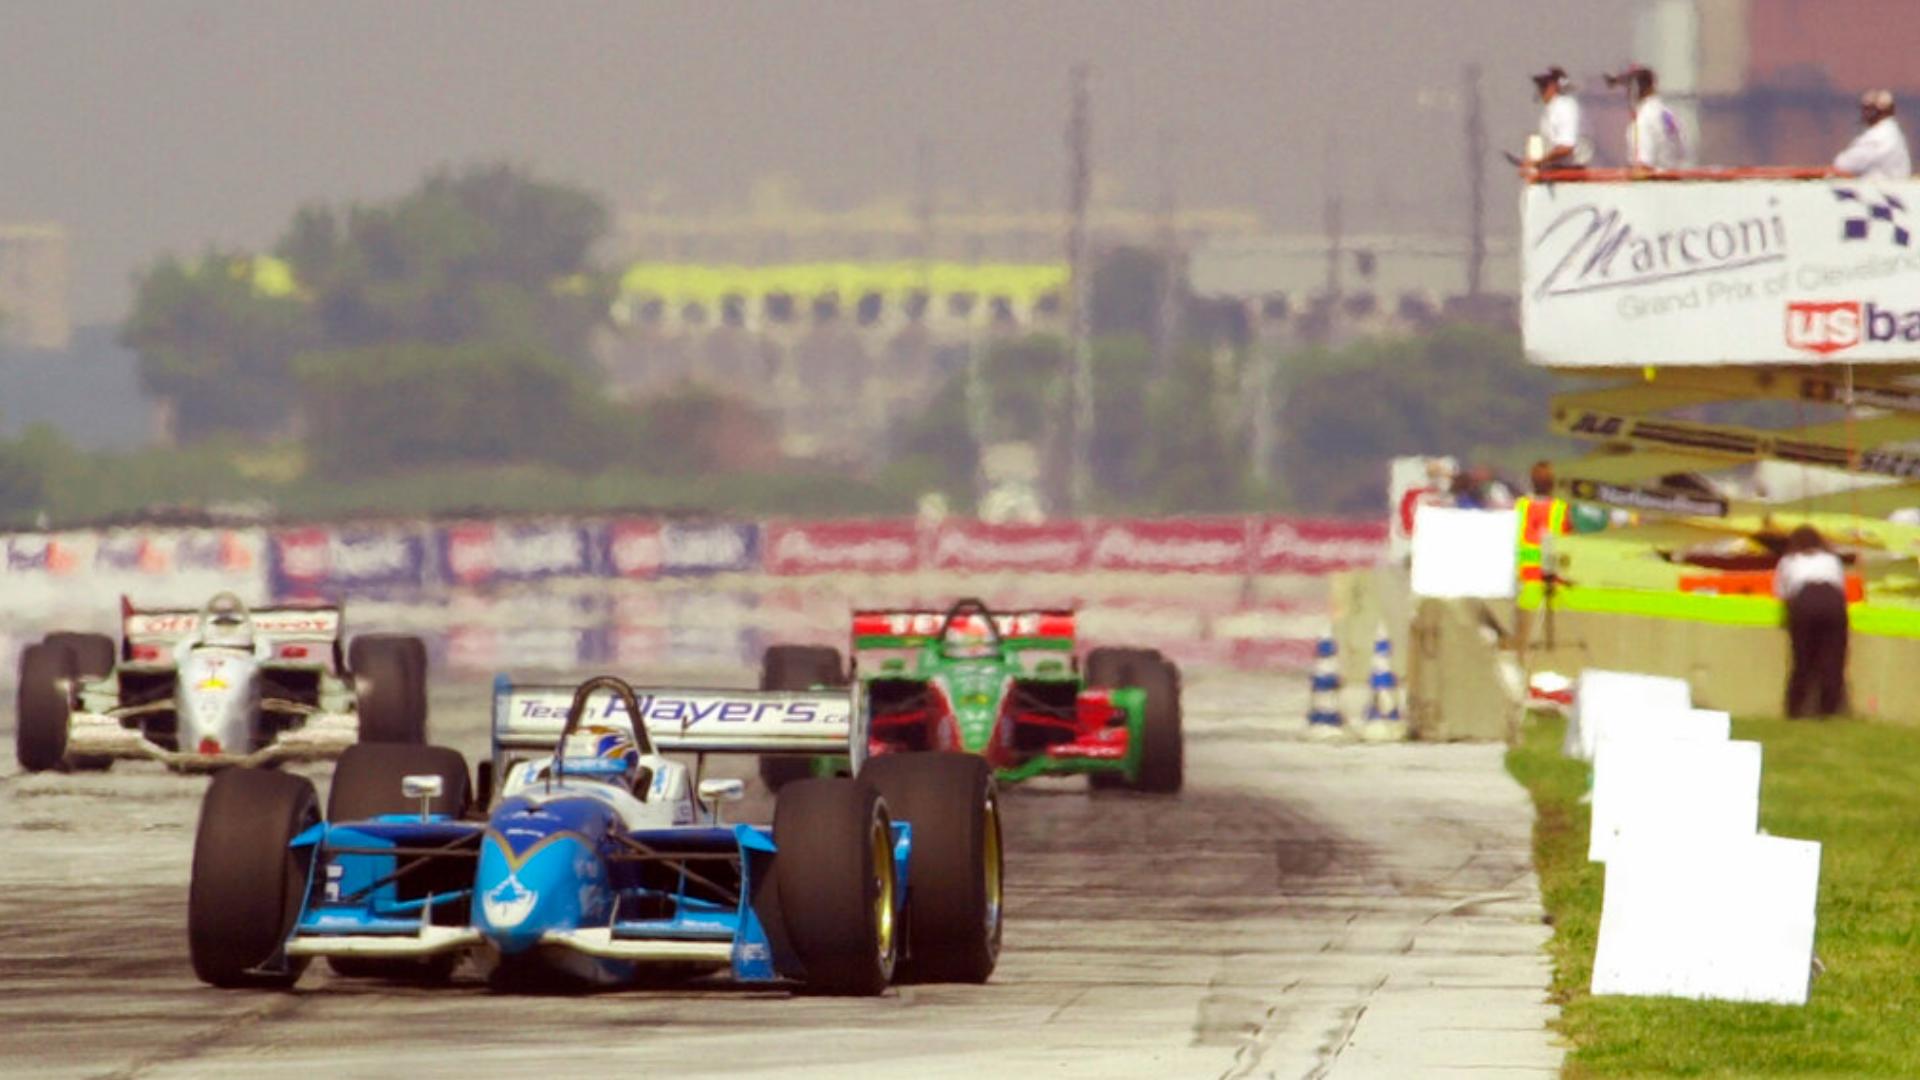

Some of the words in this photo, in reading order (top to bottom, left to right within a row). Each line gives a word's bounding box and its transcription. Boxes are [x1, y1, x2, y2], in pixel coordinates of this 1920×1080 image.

[1534, 197, 1787, 301] Marconi
[1616, 287, 1699, 320] Grand
[1705, 276, 1753, 302] Prix
[1763, 270, 1789, 296] of
